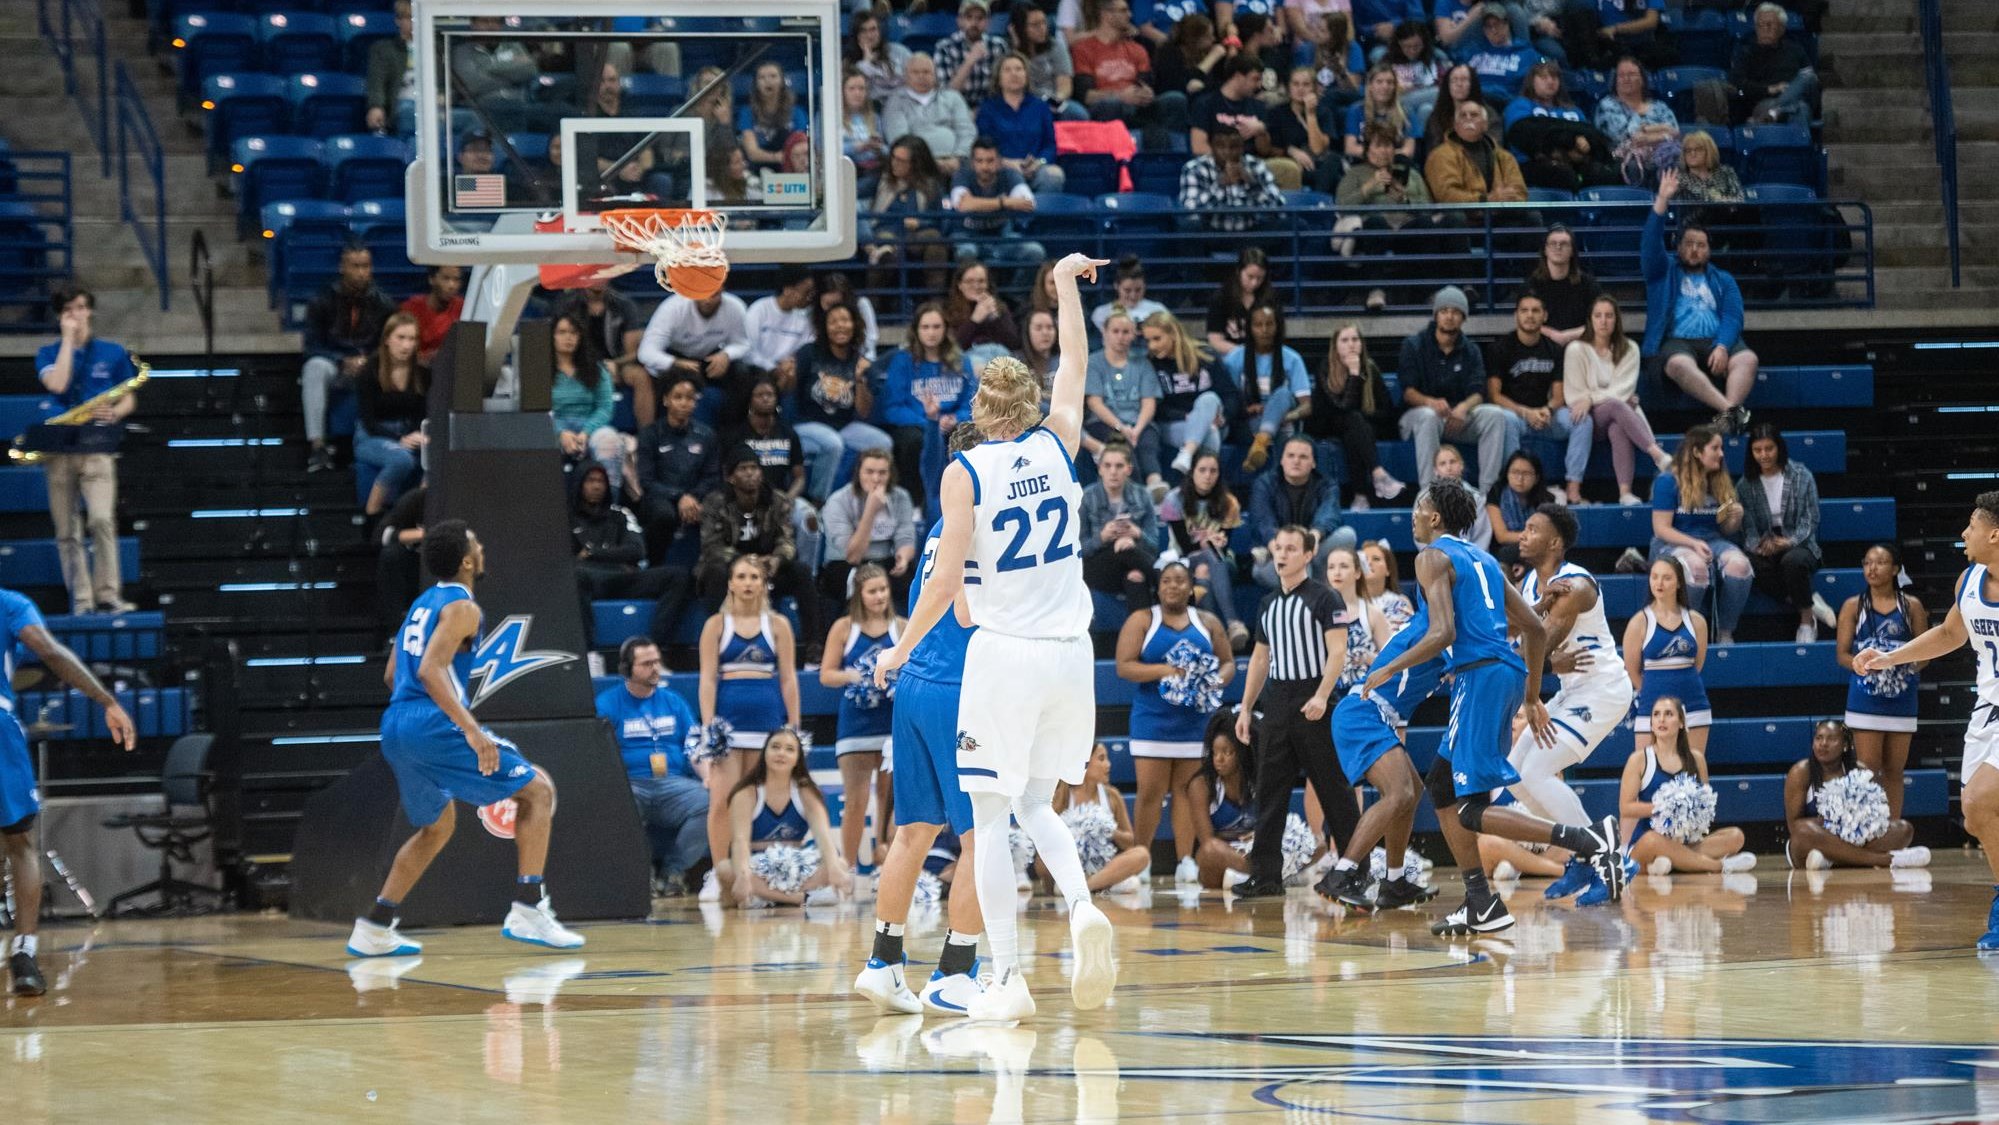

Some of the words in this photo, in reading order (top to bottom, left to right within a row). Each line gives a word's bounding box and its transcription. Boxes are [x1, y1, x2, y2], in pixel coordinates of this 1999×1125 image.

[439, 237, 480, 246] SPALDING
[1007, 474, 1050, 500] JUDE
[991, 495, 1073, 573] 22
[1473, 561, 1495, 610] 1
